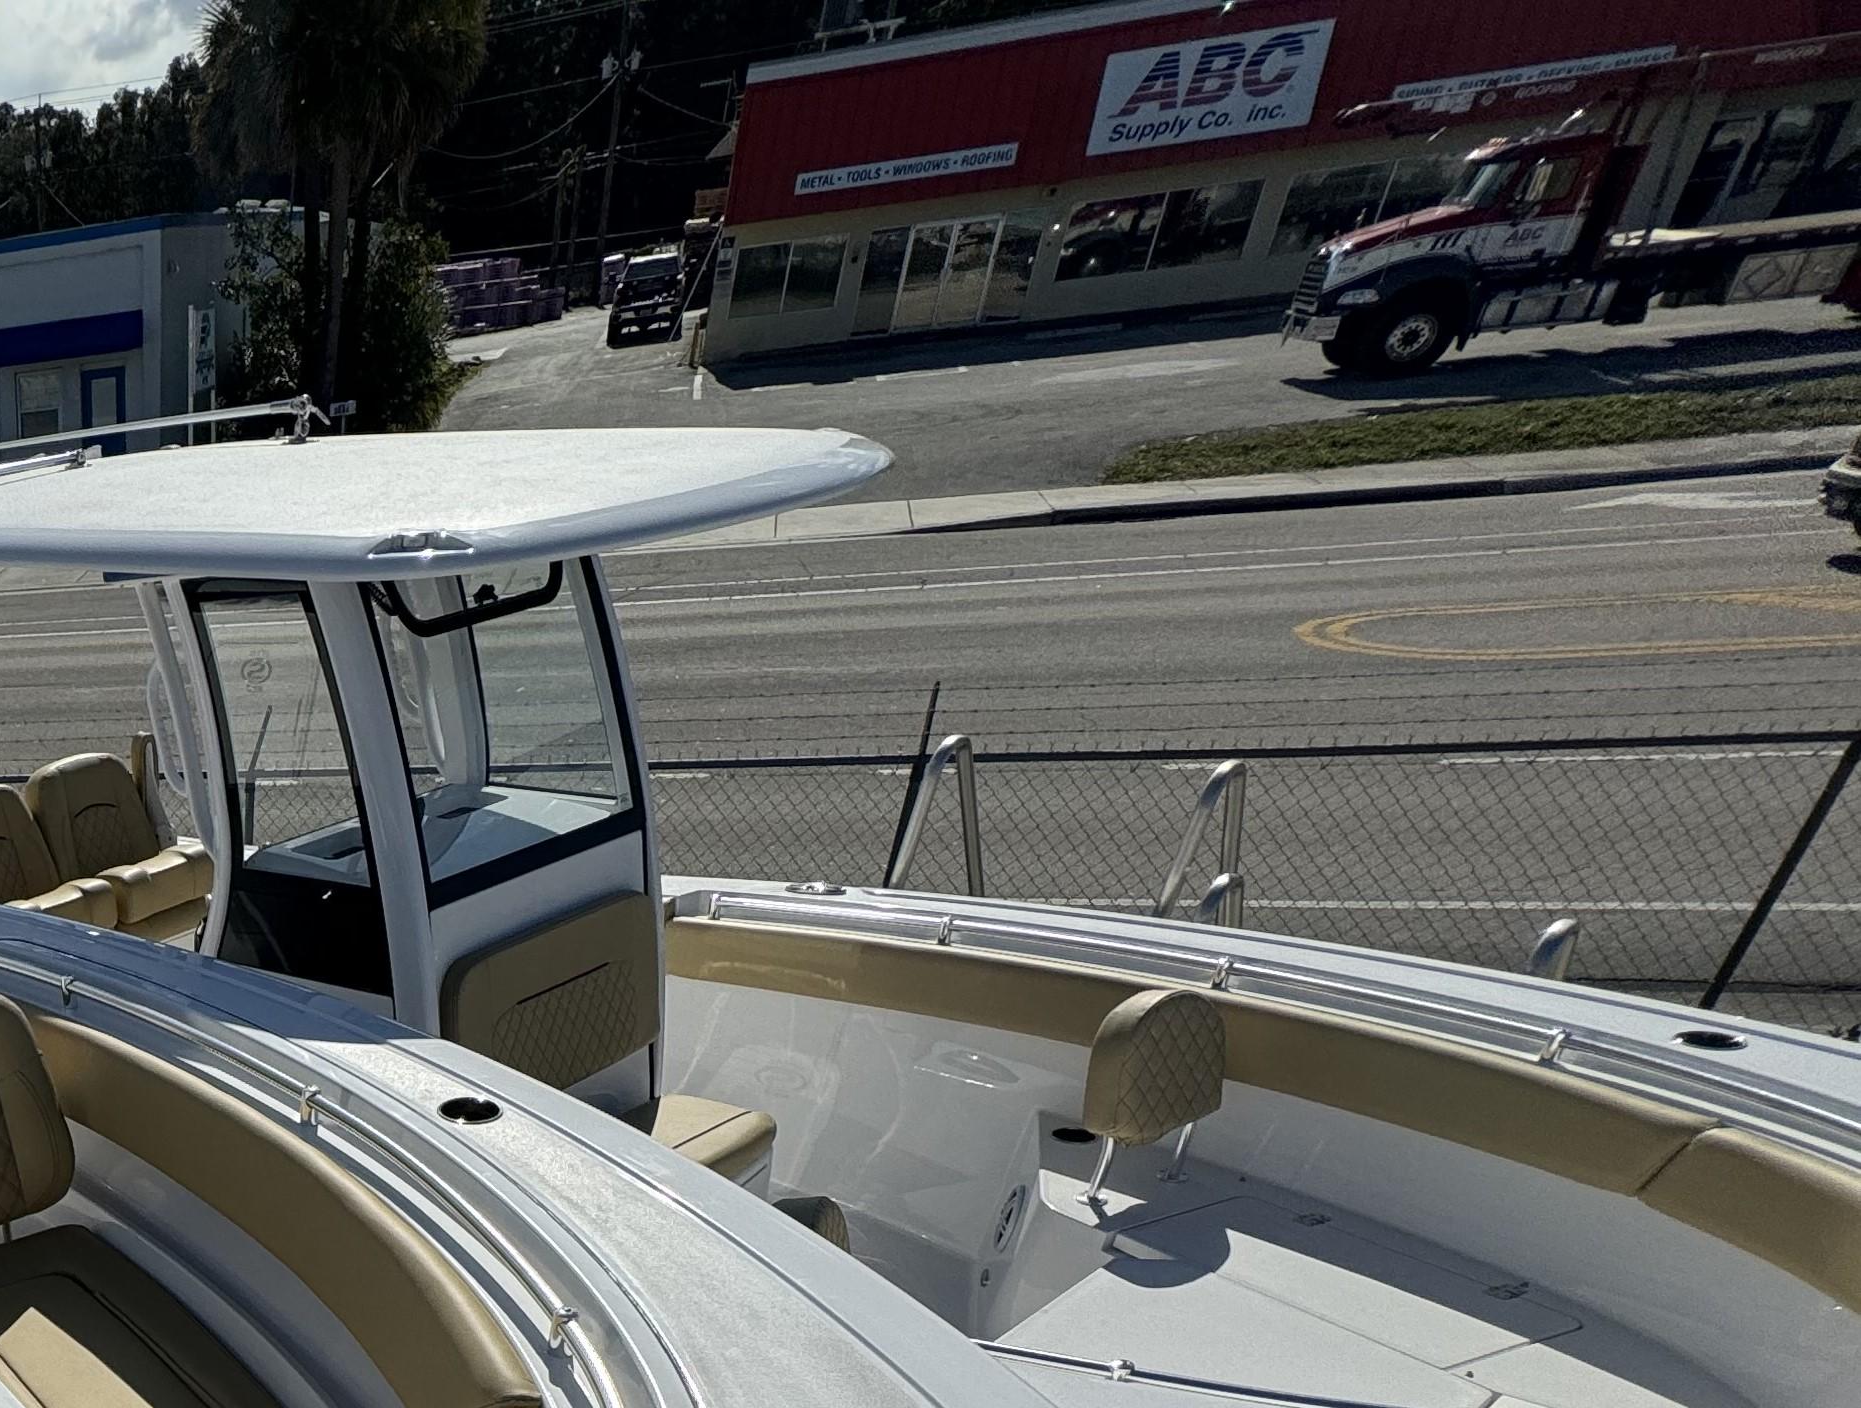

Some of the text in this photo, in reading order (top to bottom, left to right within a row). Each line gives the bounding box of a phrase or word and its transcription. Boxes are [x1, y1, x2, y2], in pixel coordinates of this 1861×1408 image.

[1107, 29, 1320, 119] ABC
[1108, 117, 1193, 144] Supply
[1198, 111, 1232, 129] Co.
[800, 148, 1013, 190] METAL TOOLS WINDOWS ROOFING
